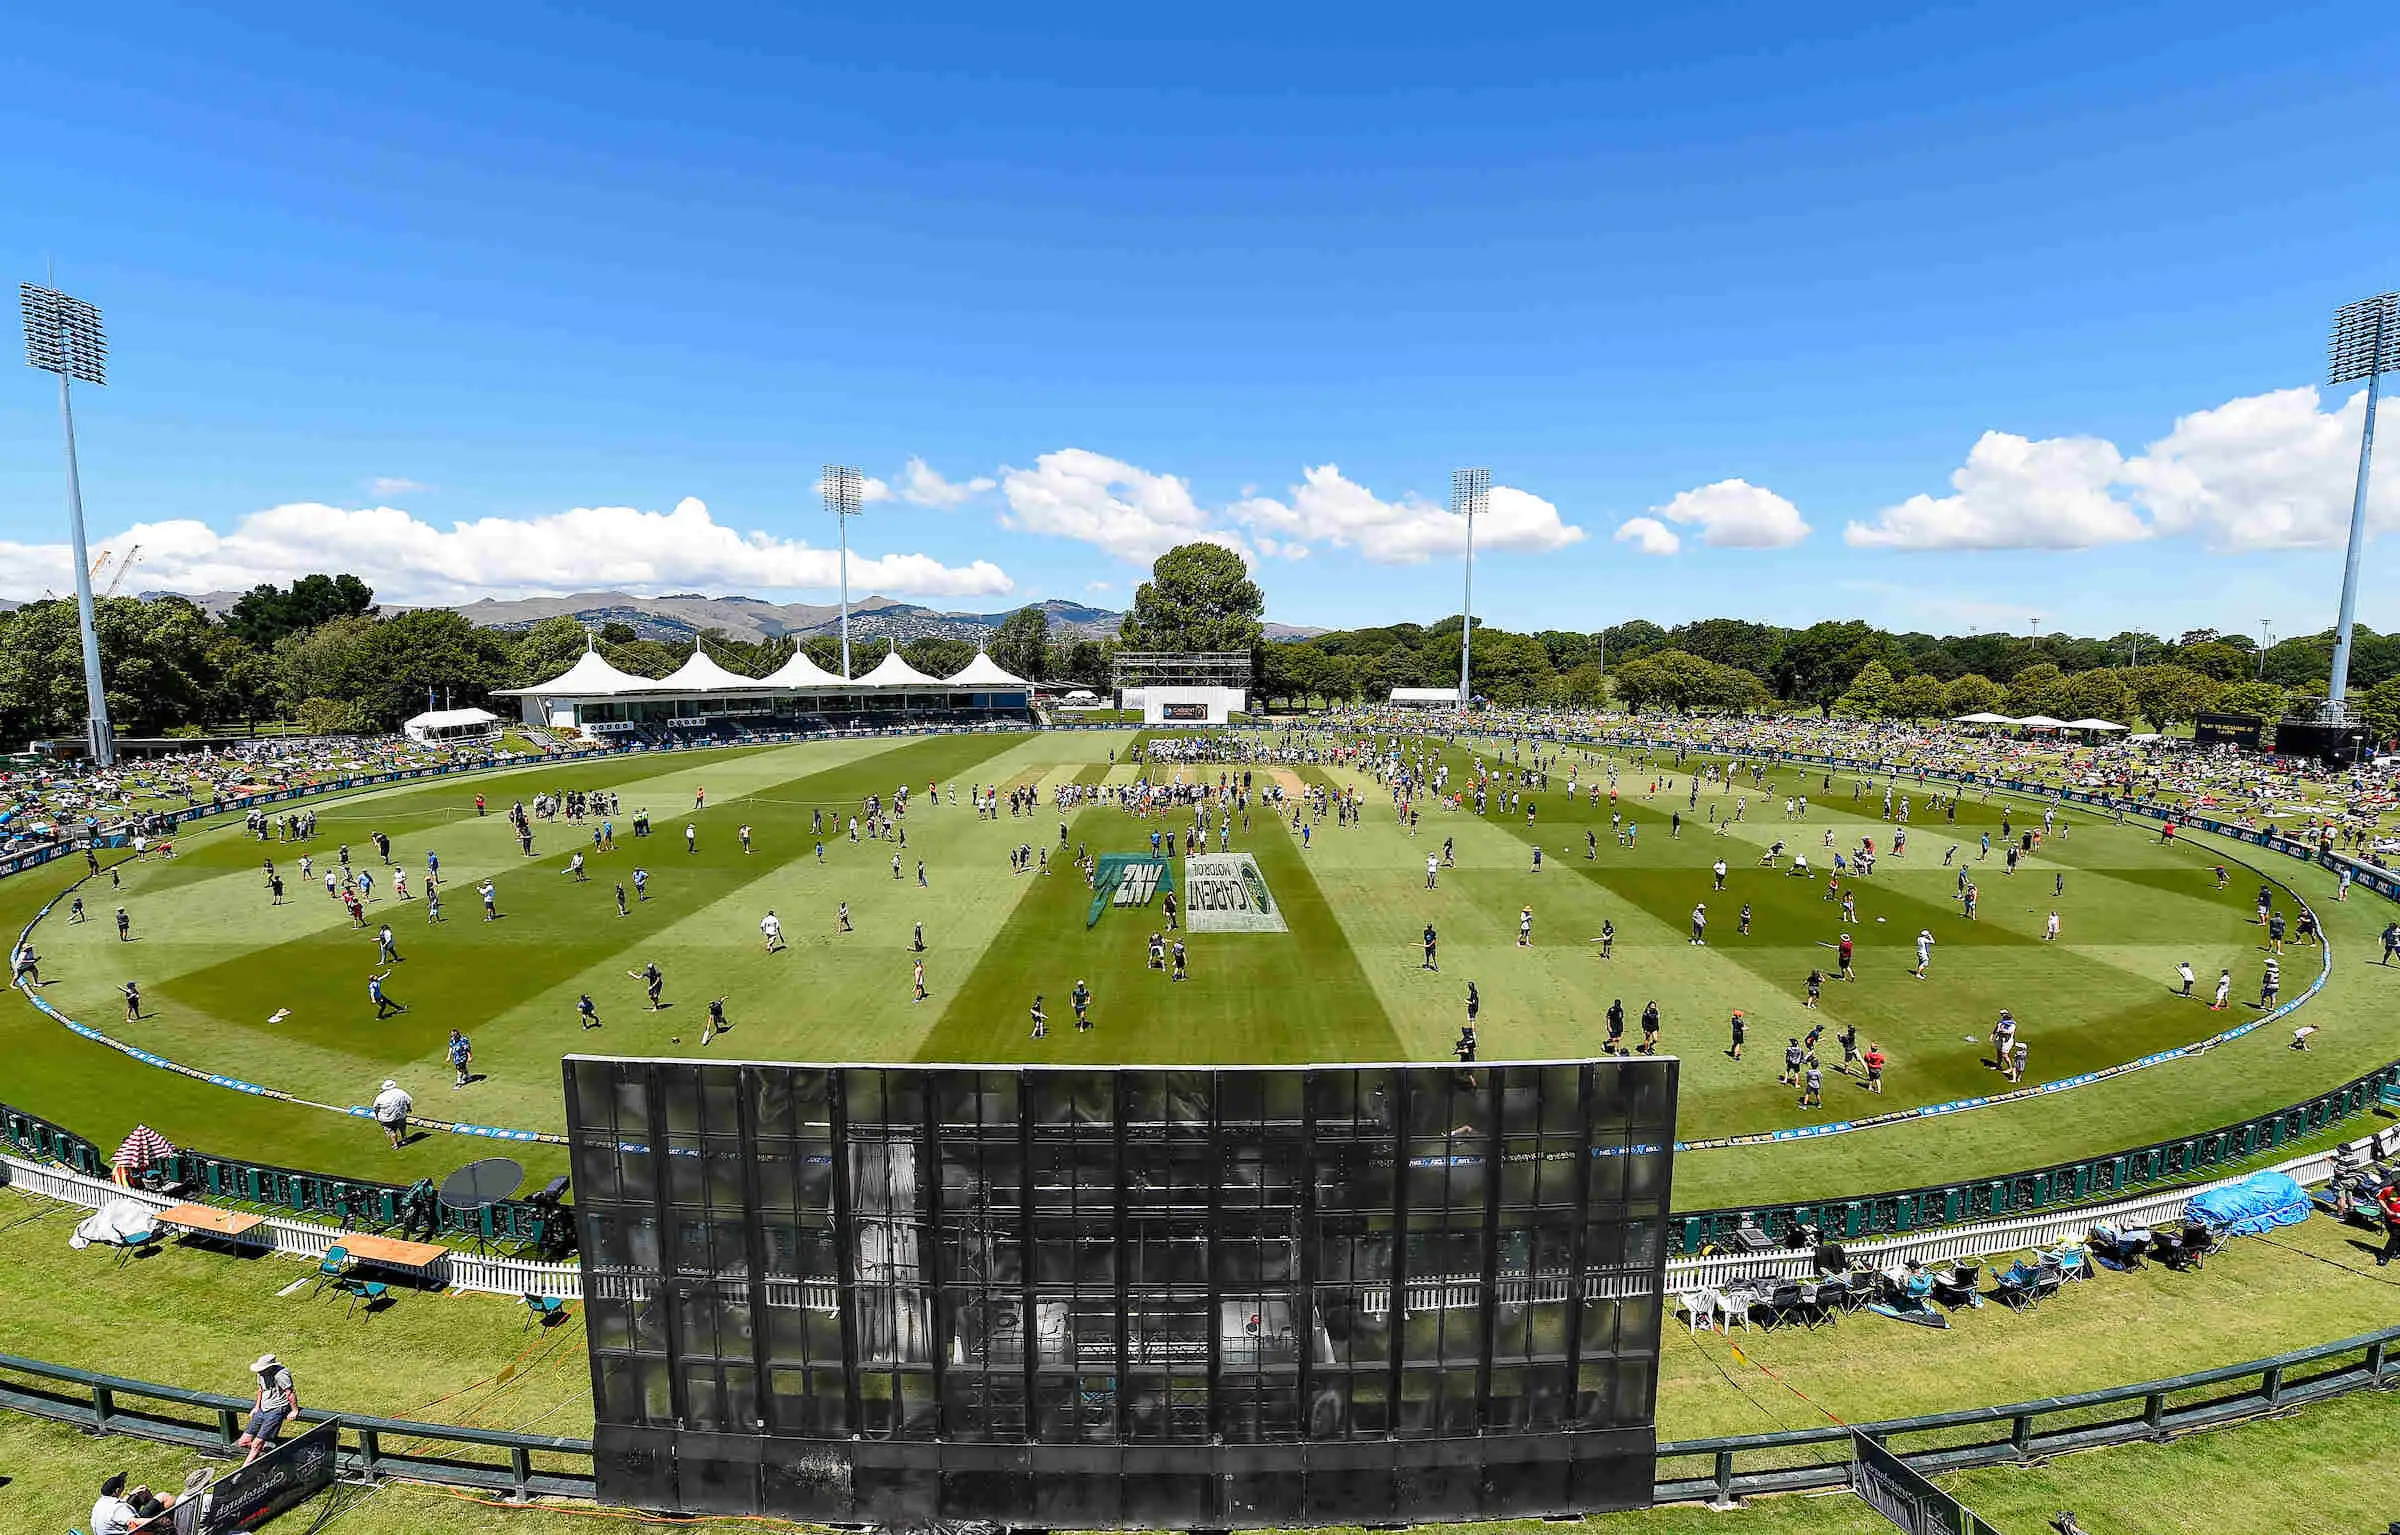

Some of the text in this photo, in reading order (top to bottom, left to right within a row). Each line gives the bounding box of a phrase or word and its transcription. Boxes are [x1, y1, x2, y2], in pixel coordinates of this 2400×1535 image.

[1207, 863, 1232, 876] MOTOR
[1112, 864, 1163, 907] ANZ
[1188, 880, 1247, 911] CARIENT
